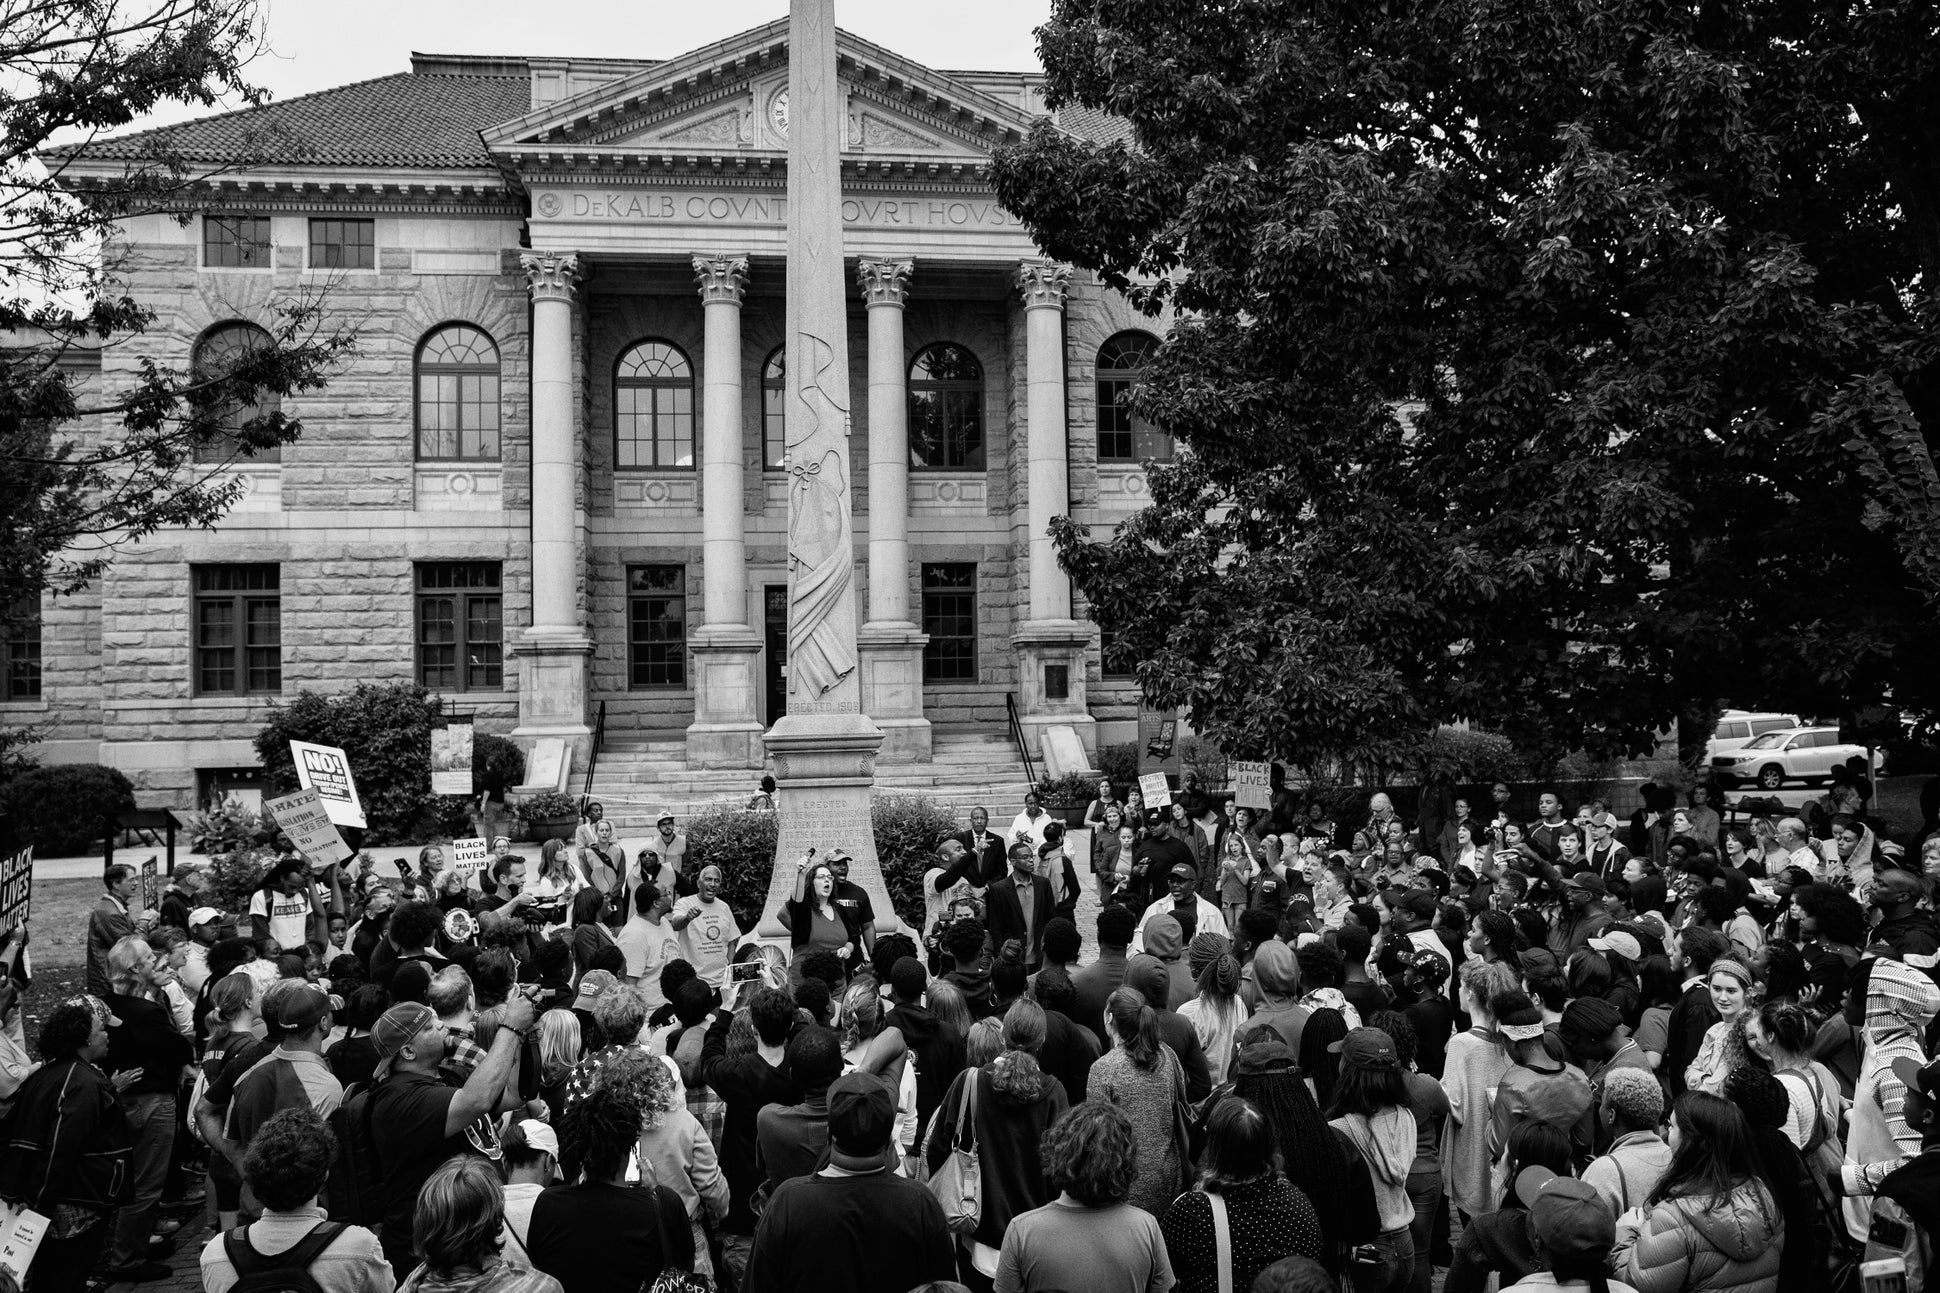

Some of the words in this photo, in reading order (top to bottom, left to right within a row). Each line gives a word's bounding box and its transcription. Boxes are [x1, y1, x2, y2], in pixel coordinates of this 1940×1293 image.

[686, 196, 787, 221] COVNT
[842, 200, 918, 223] OVRT
[303, 750, 344, 774] NO!
[1238, 762, 1270, 775] BLACK
[1240, 775, 1268, 786] LIVES
[274, 793, 316, 812] HATE
[298, 837, 312, 845] NO
[455, 841, 485, 850] BLACK
[3, 844, 34, 883] BLACK
[455, 851, 486, 861] LIVES
[2, 870, 30, 912] LIVES
